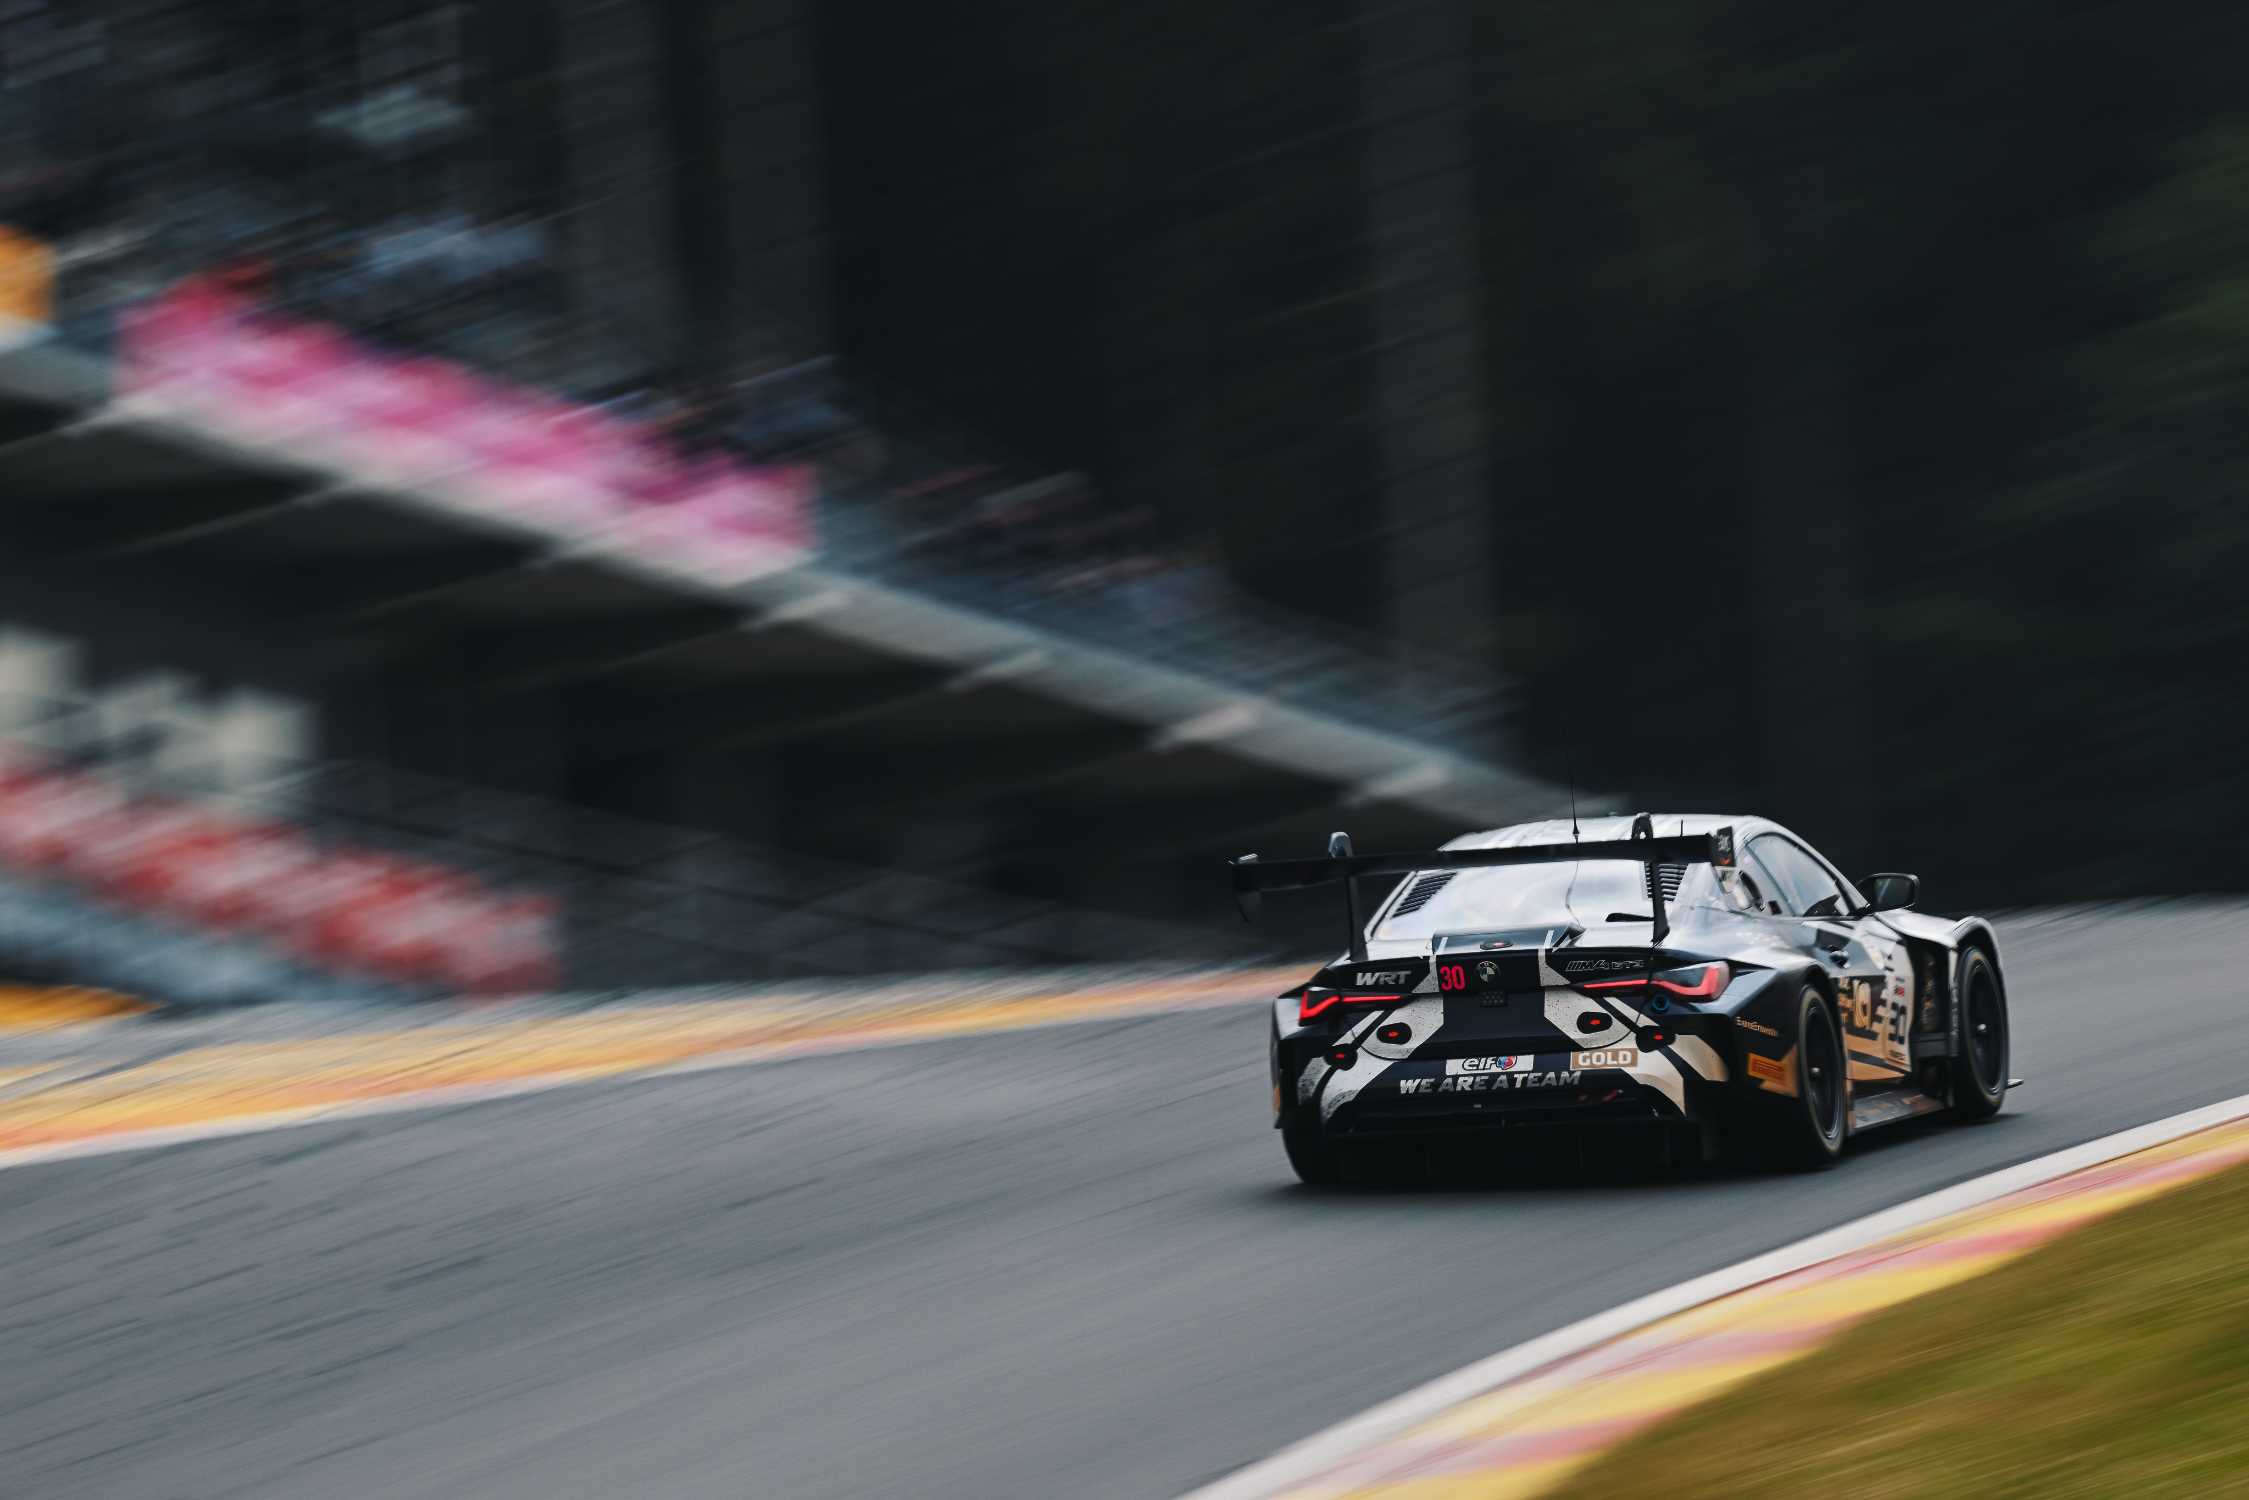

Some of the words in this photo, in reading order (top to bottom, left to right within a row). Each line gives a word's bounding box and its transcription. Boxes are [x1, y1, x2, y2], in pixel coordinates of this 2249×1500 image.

[1355, 970, 1412, 986] WRT
[1439, 965, 1466, 991] 30
[1462, 1056, 1498, 1071] elf
[1577, 1050, 1632, 1068] GOLD
[1399, 1077, 1437, 1095] WE
[1438, 1075, 1490, 1093] ARE
[1491, 1074, 1509, 1089] A
[1512, 1070, 1583, 1089] TEAM
